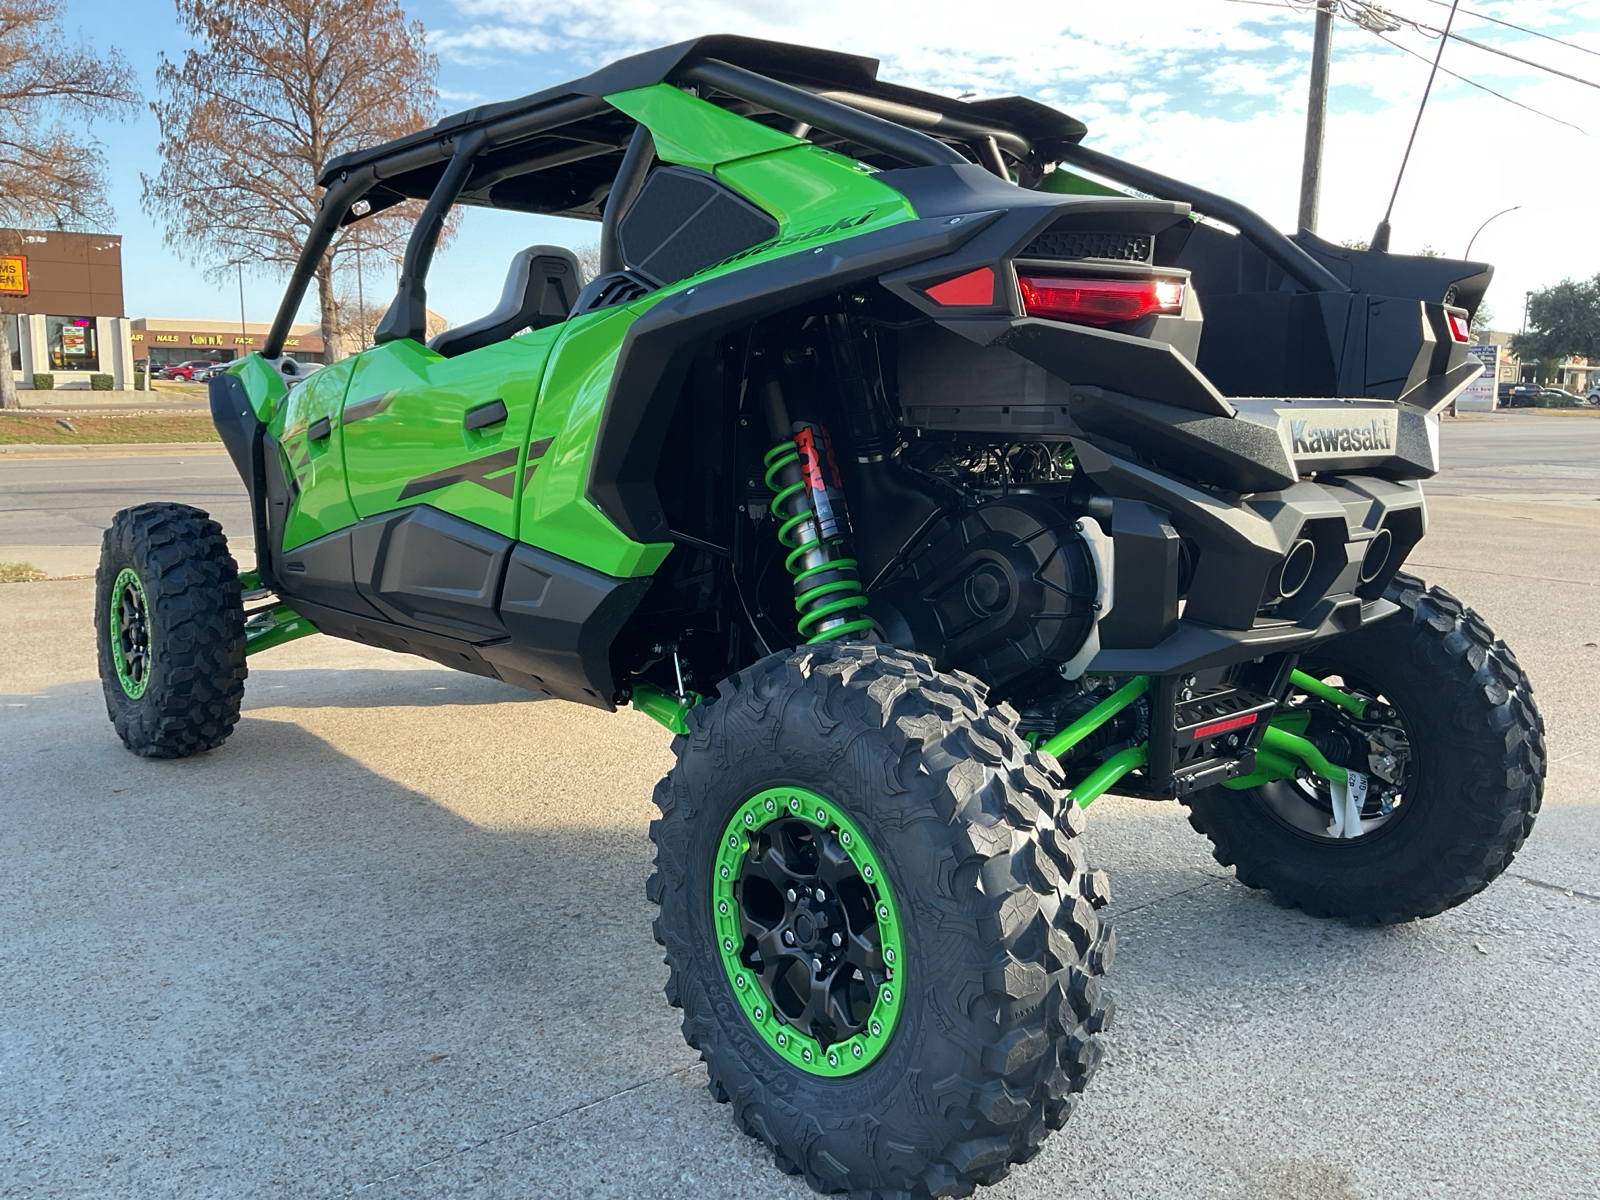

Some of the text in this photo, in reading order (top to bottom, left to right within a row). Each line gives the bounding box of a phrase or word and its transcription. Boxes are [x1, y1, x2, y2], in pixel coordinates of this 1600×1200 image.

[156, 334, 179, 343] NAILS
[234, 337, 254, 345] FACE
[1290, 418, 1391, 454] Kawasaki
[793, 426, 825, 497] FOX
